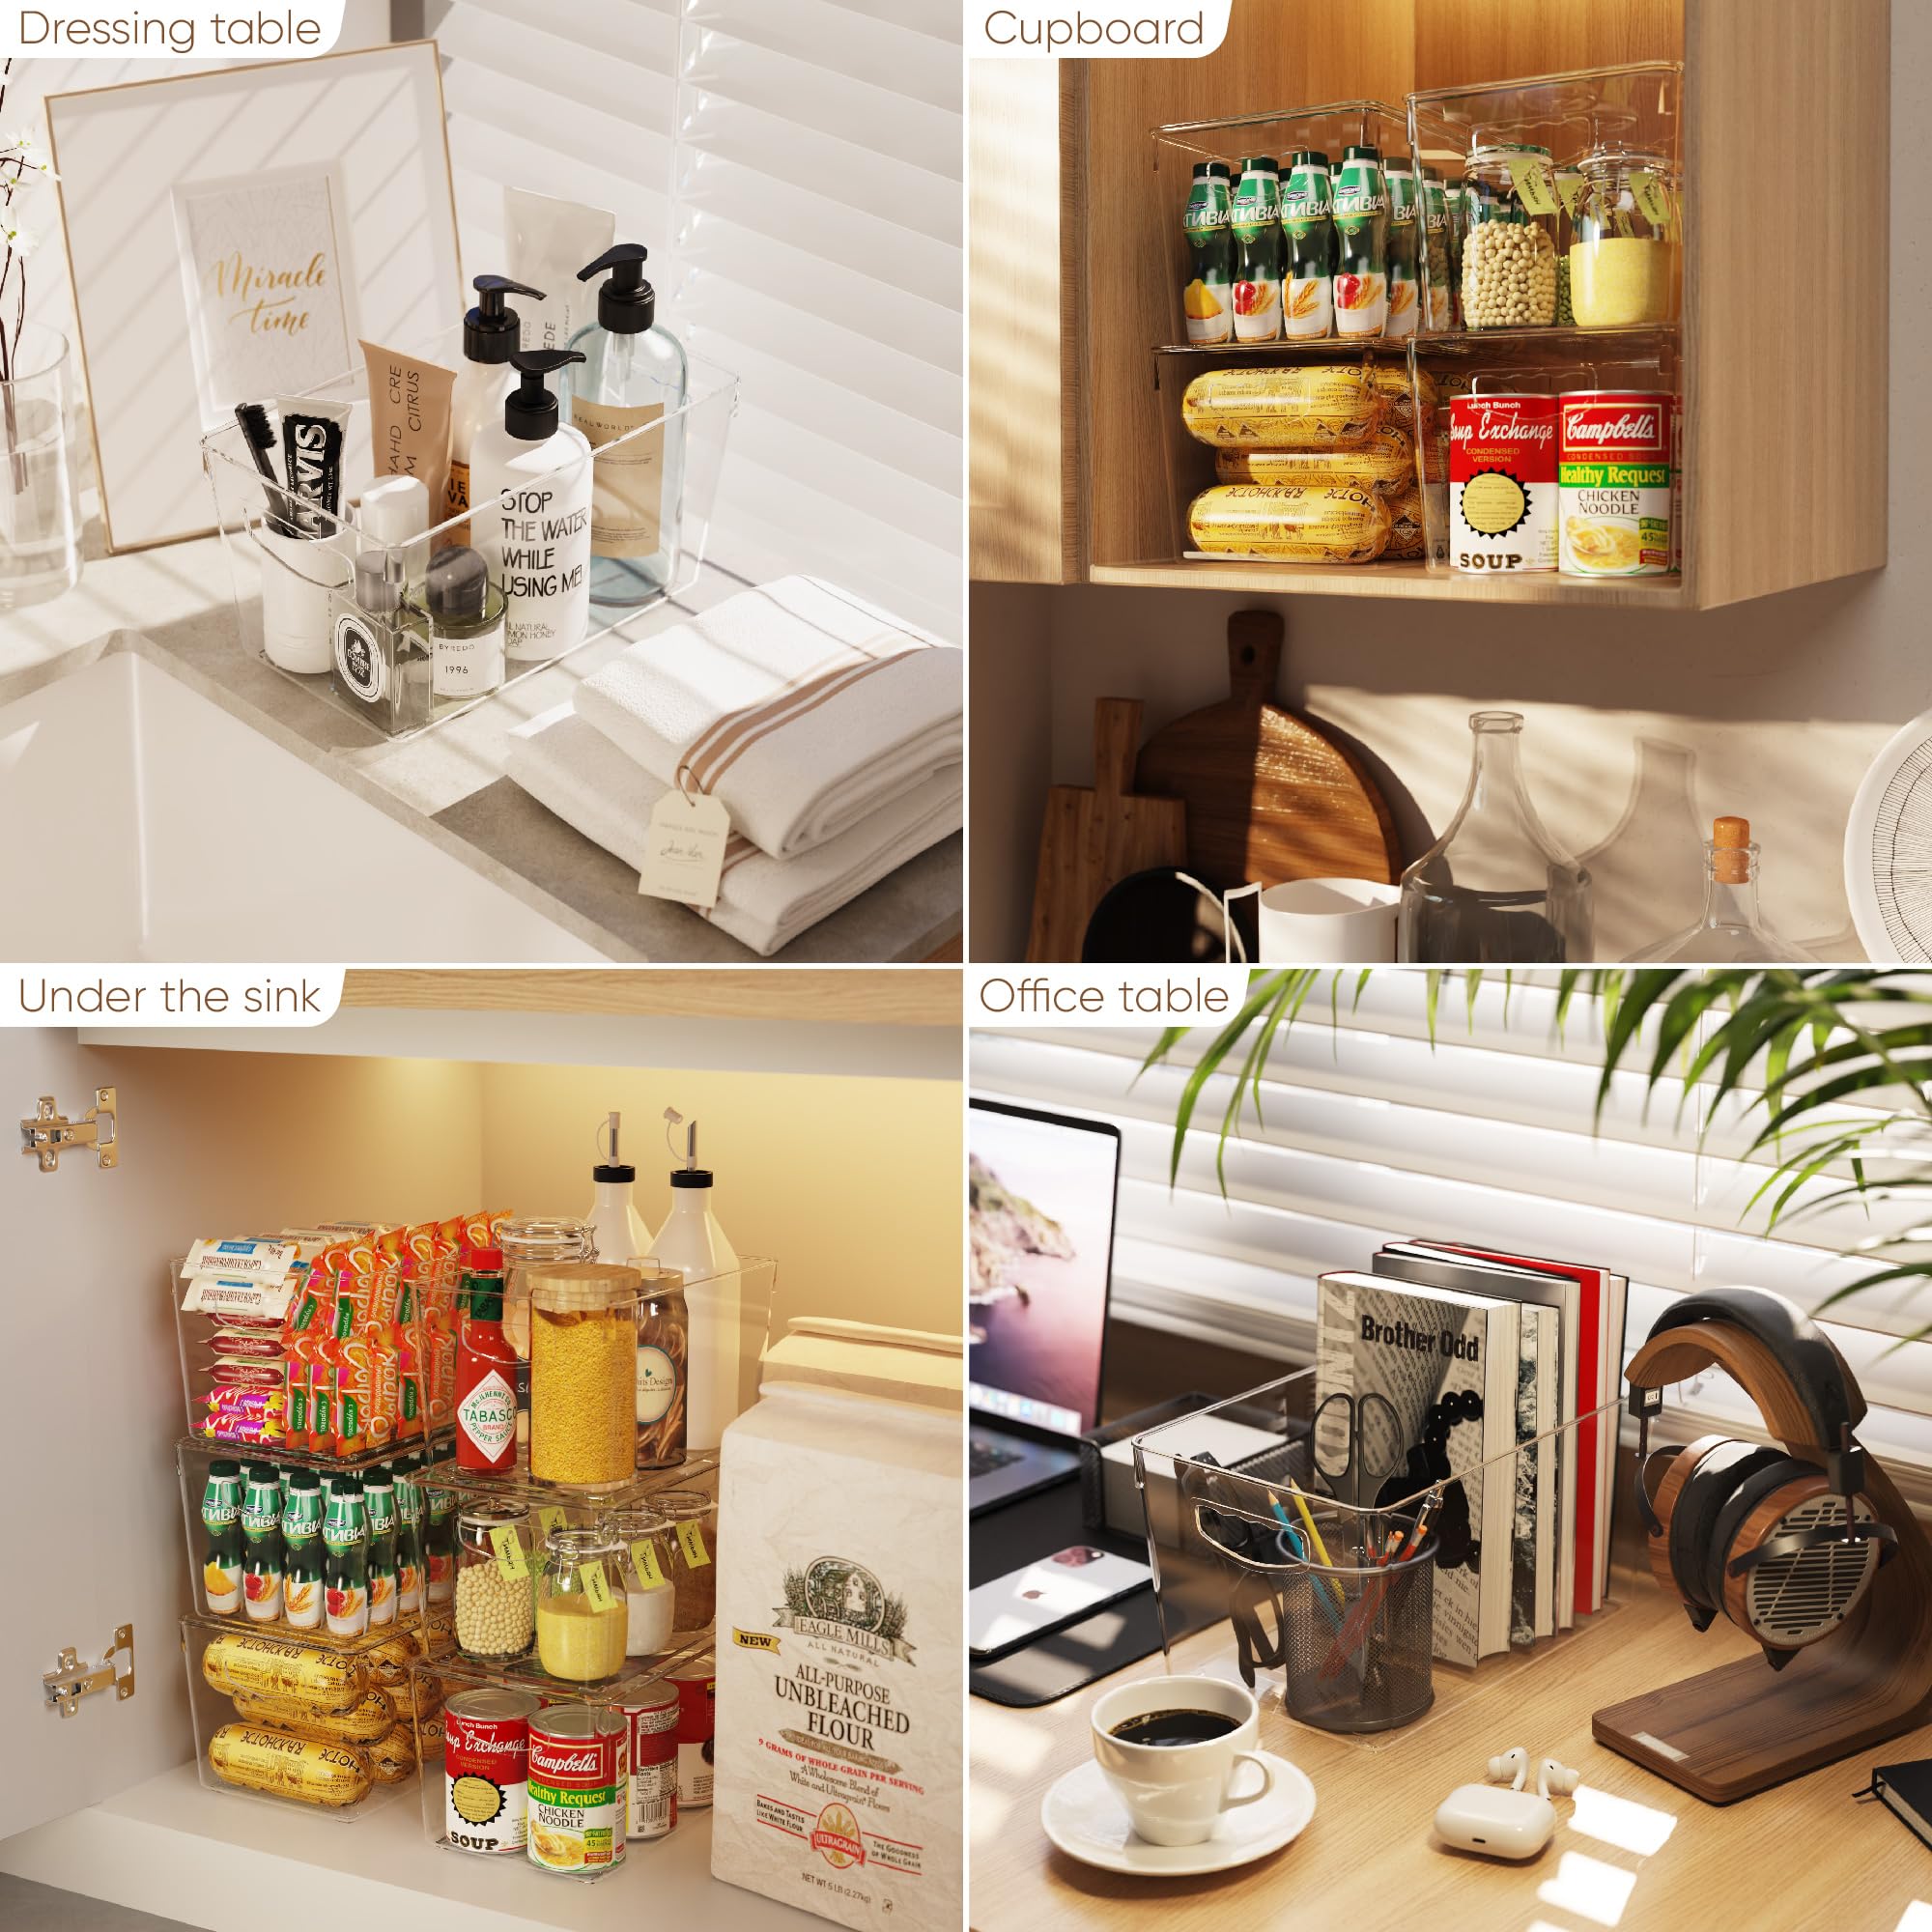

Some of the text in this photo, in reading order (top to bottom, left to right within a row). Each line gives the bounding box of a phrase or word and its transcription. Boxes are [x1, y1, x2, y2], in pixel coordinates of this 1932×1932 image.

[205, 250, 327, 301] Miracle
[230, 297, 310, 335] time
[407, 371, 422, 432] CITRUS
[1492, 401, 1521, 410] Bunch
[1478, 411, 1553, 450] Exchange
[1566, 412, 1656, 444] Campbell's
[1465, 447, 1520, 456] CONDENSED
[1607, 467, 1665, 487] Request
[500, 488, 554, 514] STOP
[1577, 490, 1641, 503] CHICKEN
[1577, 501, 1640, 516] NOODLE
[501, 518, 538, 542] THE
[541, 507, 588, 542] WATER
[501, 545, 555, 570] WHILE
[1459, 552, 1523, 570] SOUP
[501, 573, 557, 598] USING
[439, 642, 476, 652] BYREDO
[445, 666, 469, 674] 1996
[1361, 1314, 1480, 1362] Brother Odd
[464, 1406, 517, 1423] TABASCO
[470, 1422, 513, 1442] PEPPER SAUCE
[739, 1634, 773, 1648] NEW
[800, 1616, 890, 1657] EAGLE MILLS
[808, 1641, 880, 1668] ALL NATURAL
[796, 1662, 891, 1706] ALL-PURPOSE
[775, 1674, 911, 1736] UNBLEACHED
[808, 1711, 876, 1752] FLOUR
[465, 1729, 526, 1759] Exchange
[455, 1753, 497, 1766] CONDENSED
[460, 1761, 491, 1772] VERSION
[531, 1745, 599, 1774] Campbell's
[758, 1738, 925, 1796] 9 GRAMS OF WHOLE GRAIN PER SERVING
[789, 1770, 810, 1788] White
[811, 1781, 826, 1794] and
[808, 1766, 848, 1788] Wholesome
[849, 1778, 870, 1796] Blend
[871, 1786, 881, 1799] of
[560, 1789, 607, 1808] Request
[537, 1803, 585, 1819] CHICKEN
[537, 1812, 585, 1829] NOODLE
[756, 1809, 804, 1833] LIKE WHITE FLOUR
[774, 1805, 785, 1816] AND
[785, 1808, 806, 1824] TASTES
[450, 1831, 499, 1851] SOUP
[815, 1833, 861, 1856] ULTRAGRAIN
[873, 1840, 921, 1861] THE GOODNESS
[880, 1851, 902, 1865] WHOLE
[902, 1858, 923, 1869] GRAIN
[802, 1872, 816, 1885] NET
[816, 1877, 828, 1889] WT
[828, 1882, 834, 1891] 5
[834, 1884, 843, 1895] LB
